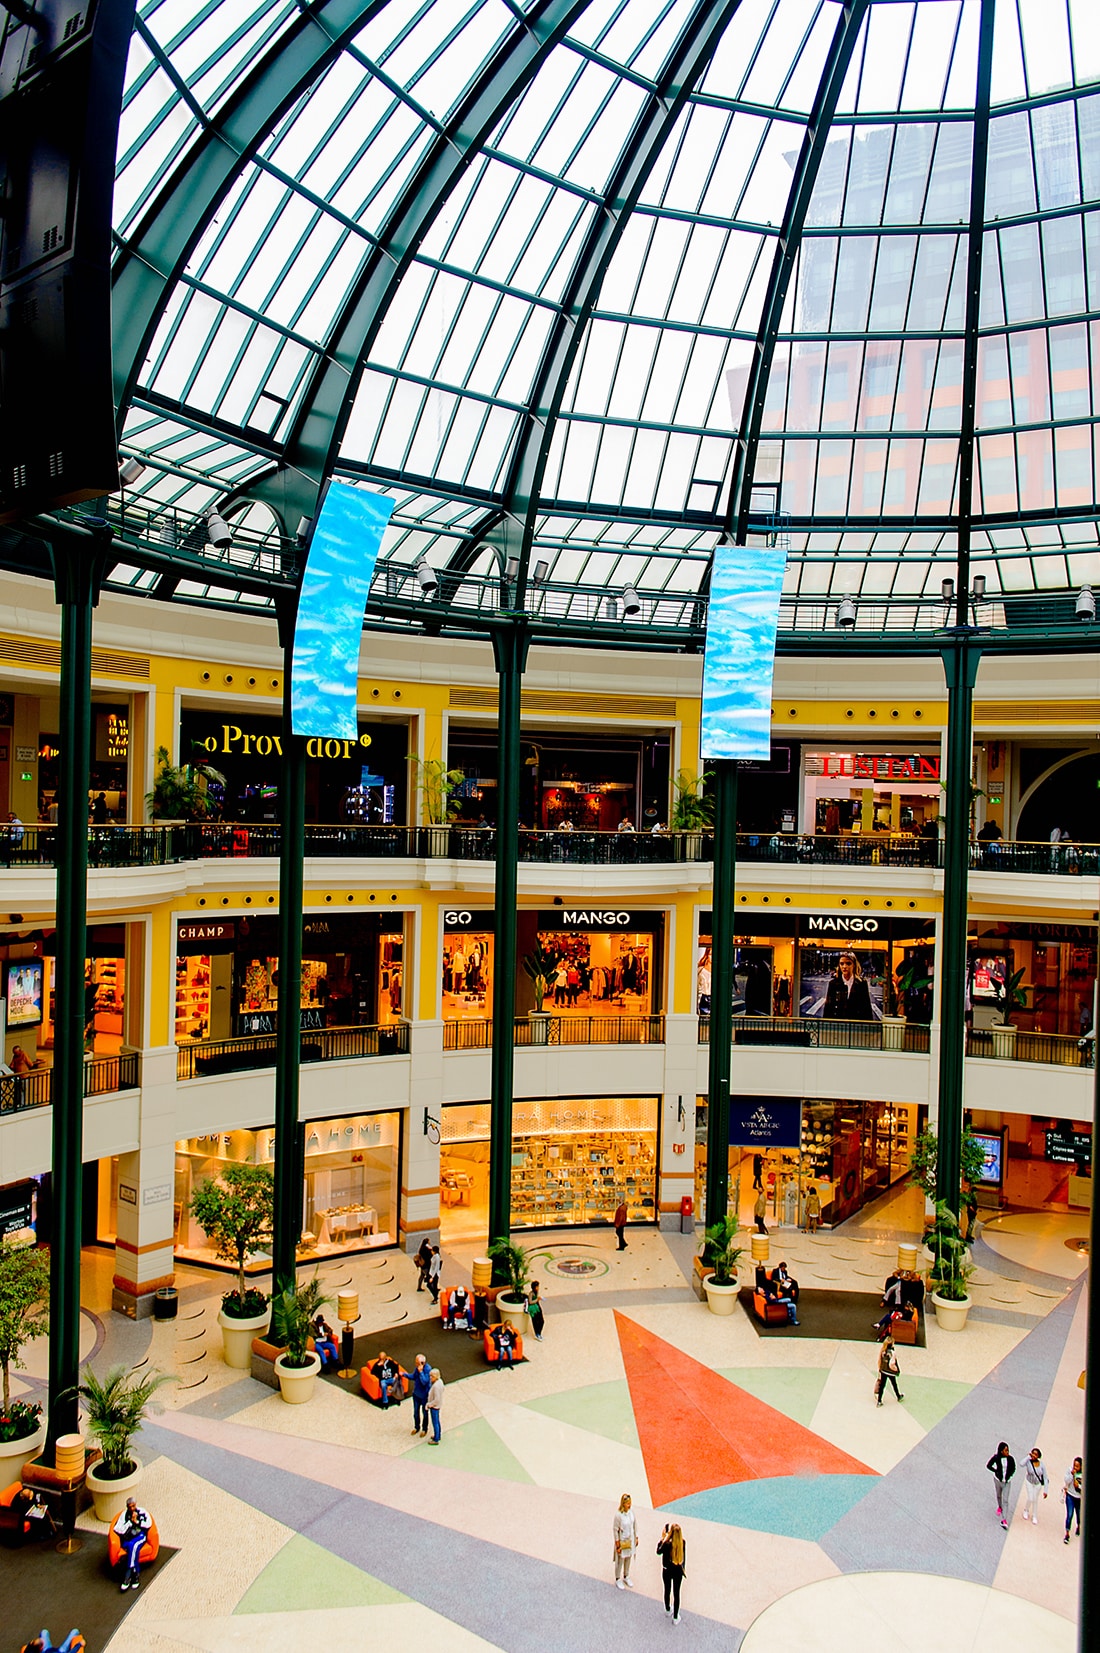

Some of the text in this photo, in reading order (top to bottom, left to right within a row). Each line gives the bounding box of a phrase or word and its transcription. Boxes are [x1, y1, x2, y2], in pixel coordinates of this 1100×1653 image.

[221, 725, 356, 759] Provdor
[822, 757, 940, 778] LUSITAN
[563, 911, 630, 925] MANGO
[808, 916, 879, 932] MANGO
[179, 926, 224, 938] CHAMP
[550, 1110, 602, 1119] HOME
[330, 1123, 382, 1137] HOME
